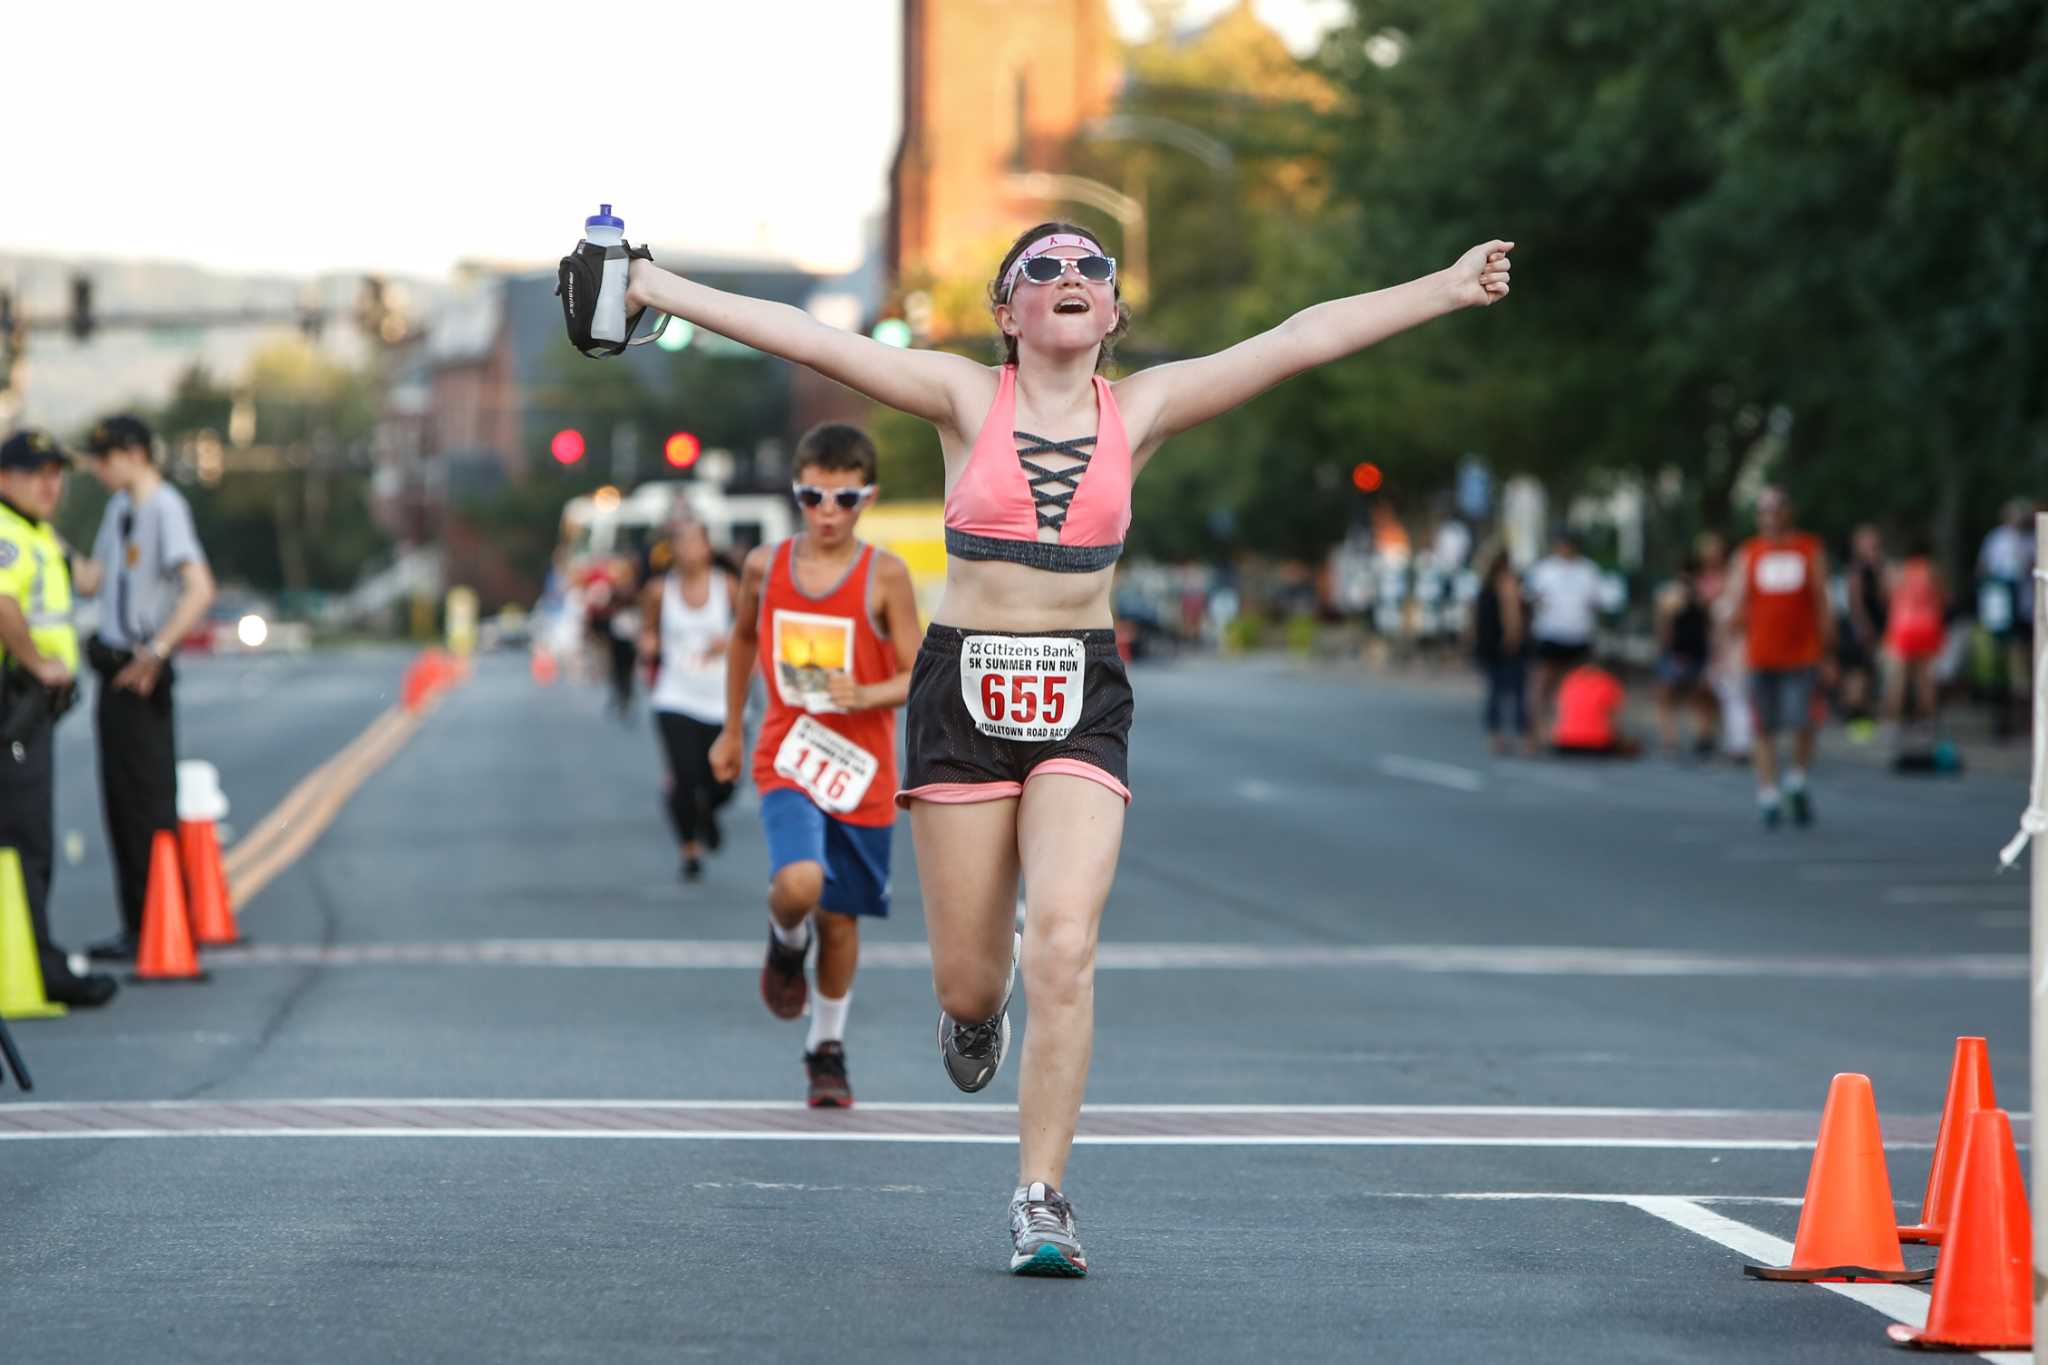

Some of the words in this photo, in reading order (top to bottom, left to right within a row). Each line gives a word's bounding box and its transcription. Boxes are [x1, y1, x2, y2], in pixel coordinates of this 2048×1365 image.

[984, 643, 1039, 657] Citizens
[1043, 644, 1074, 658] Bank
[969, 657, 982, 669] 5K
[985, 658, 1032, 671] SUMMER
[1036, 660, 1056, 672] FUN
[1059, 661, 1078, 672] RUN
[981, 673, 1067, 724] 655
[979, 723, 1023, 737] IDDLETOWN
[1026, 728, 1048, 737] ROAD
[795, 748, 850, 800] 116
